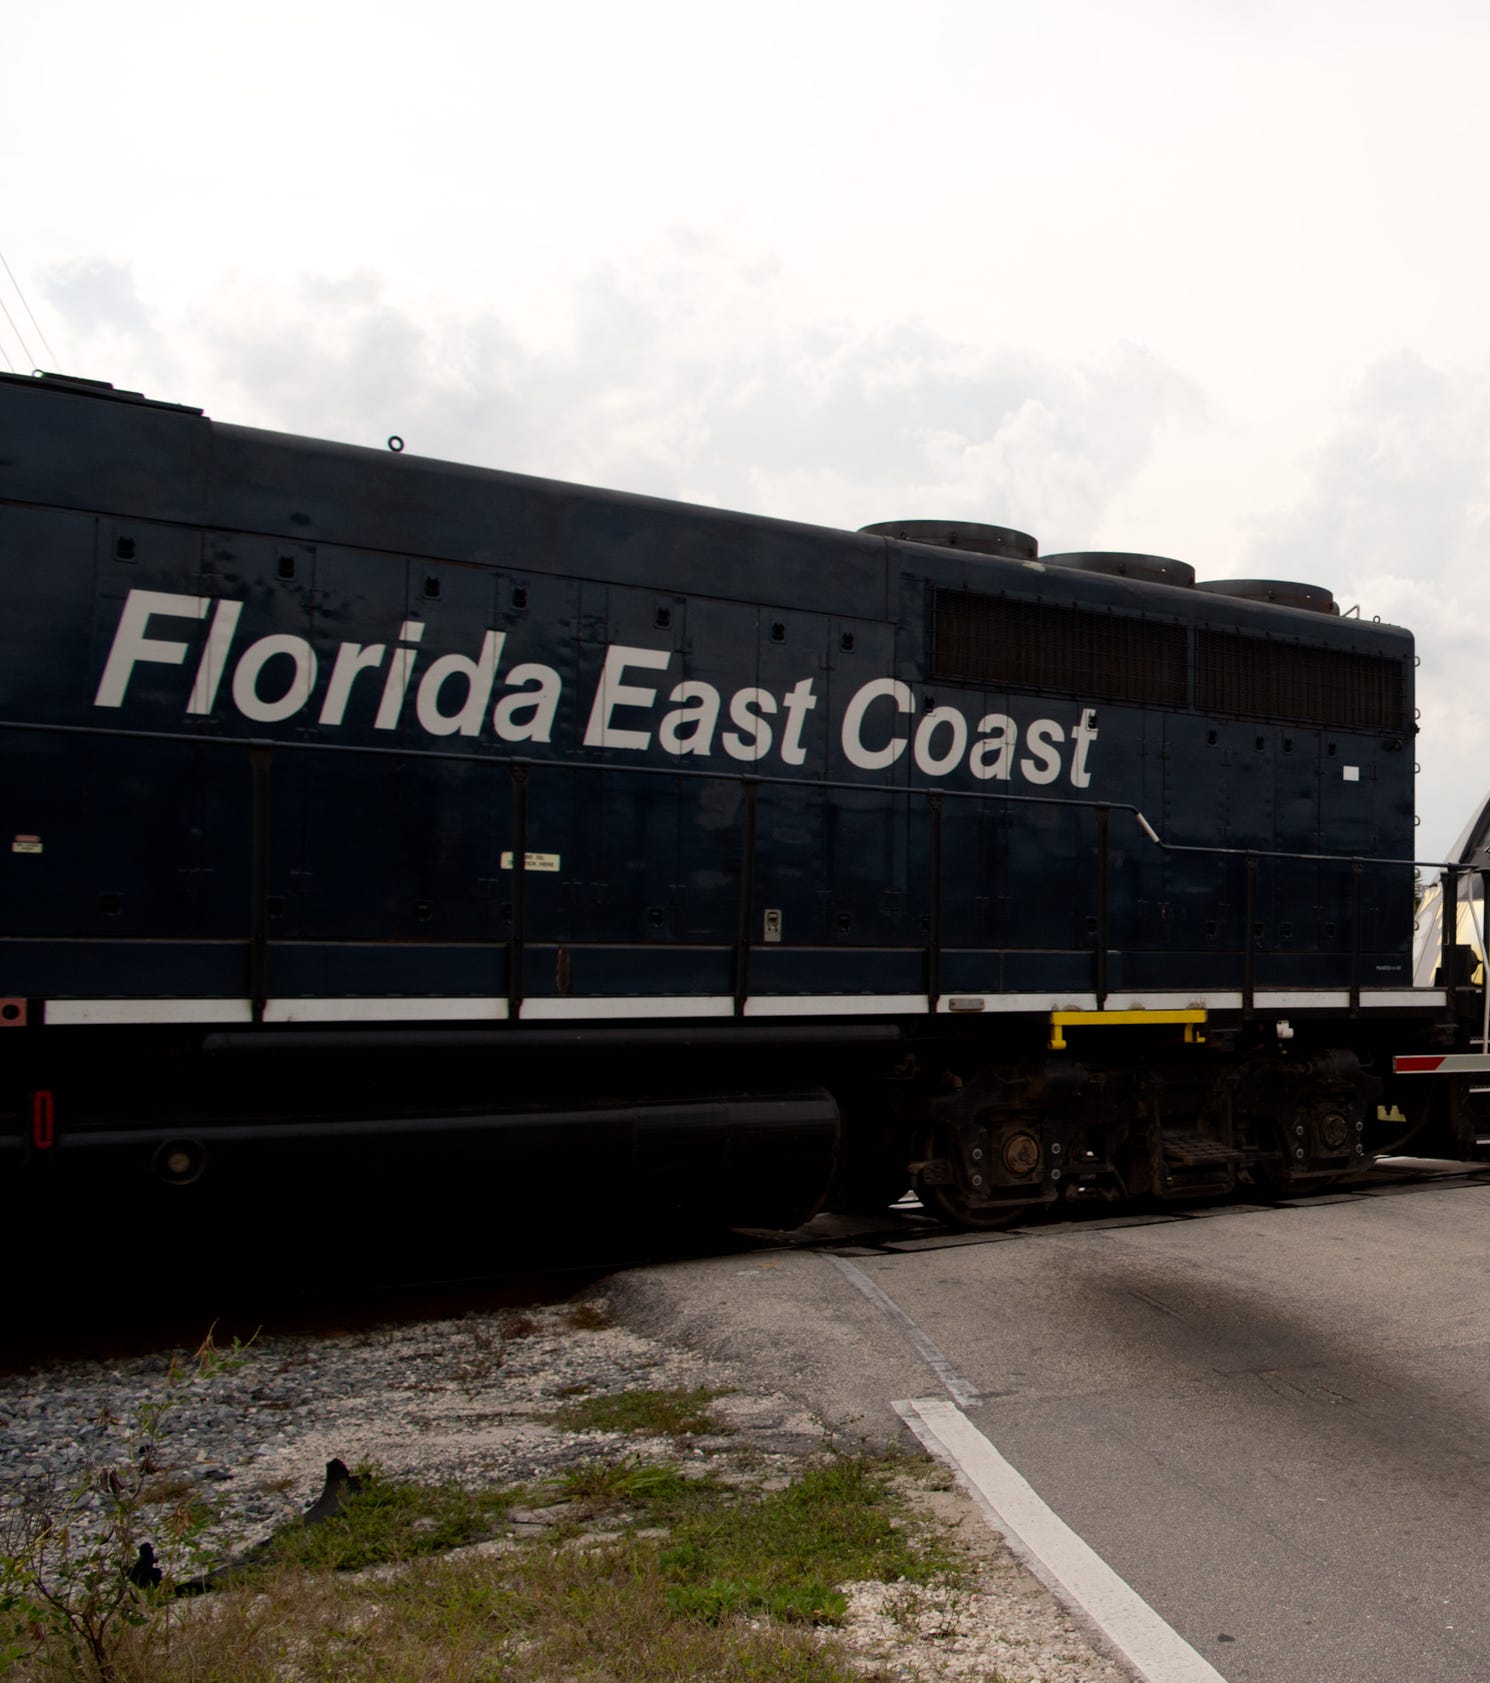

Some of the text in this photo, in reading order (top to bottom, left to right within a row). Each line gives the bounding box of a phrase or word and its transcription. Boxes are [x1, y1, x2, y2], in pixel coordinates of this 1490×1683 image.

[94, 589, 1099, 789] Florida East Coast
